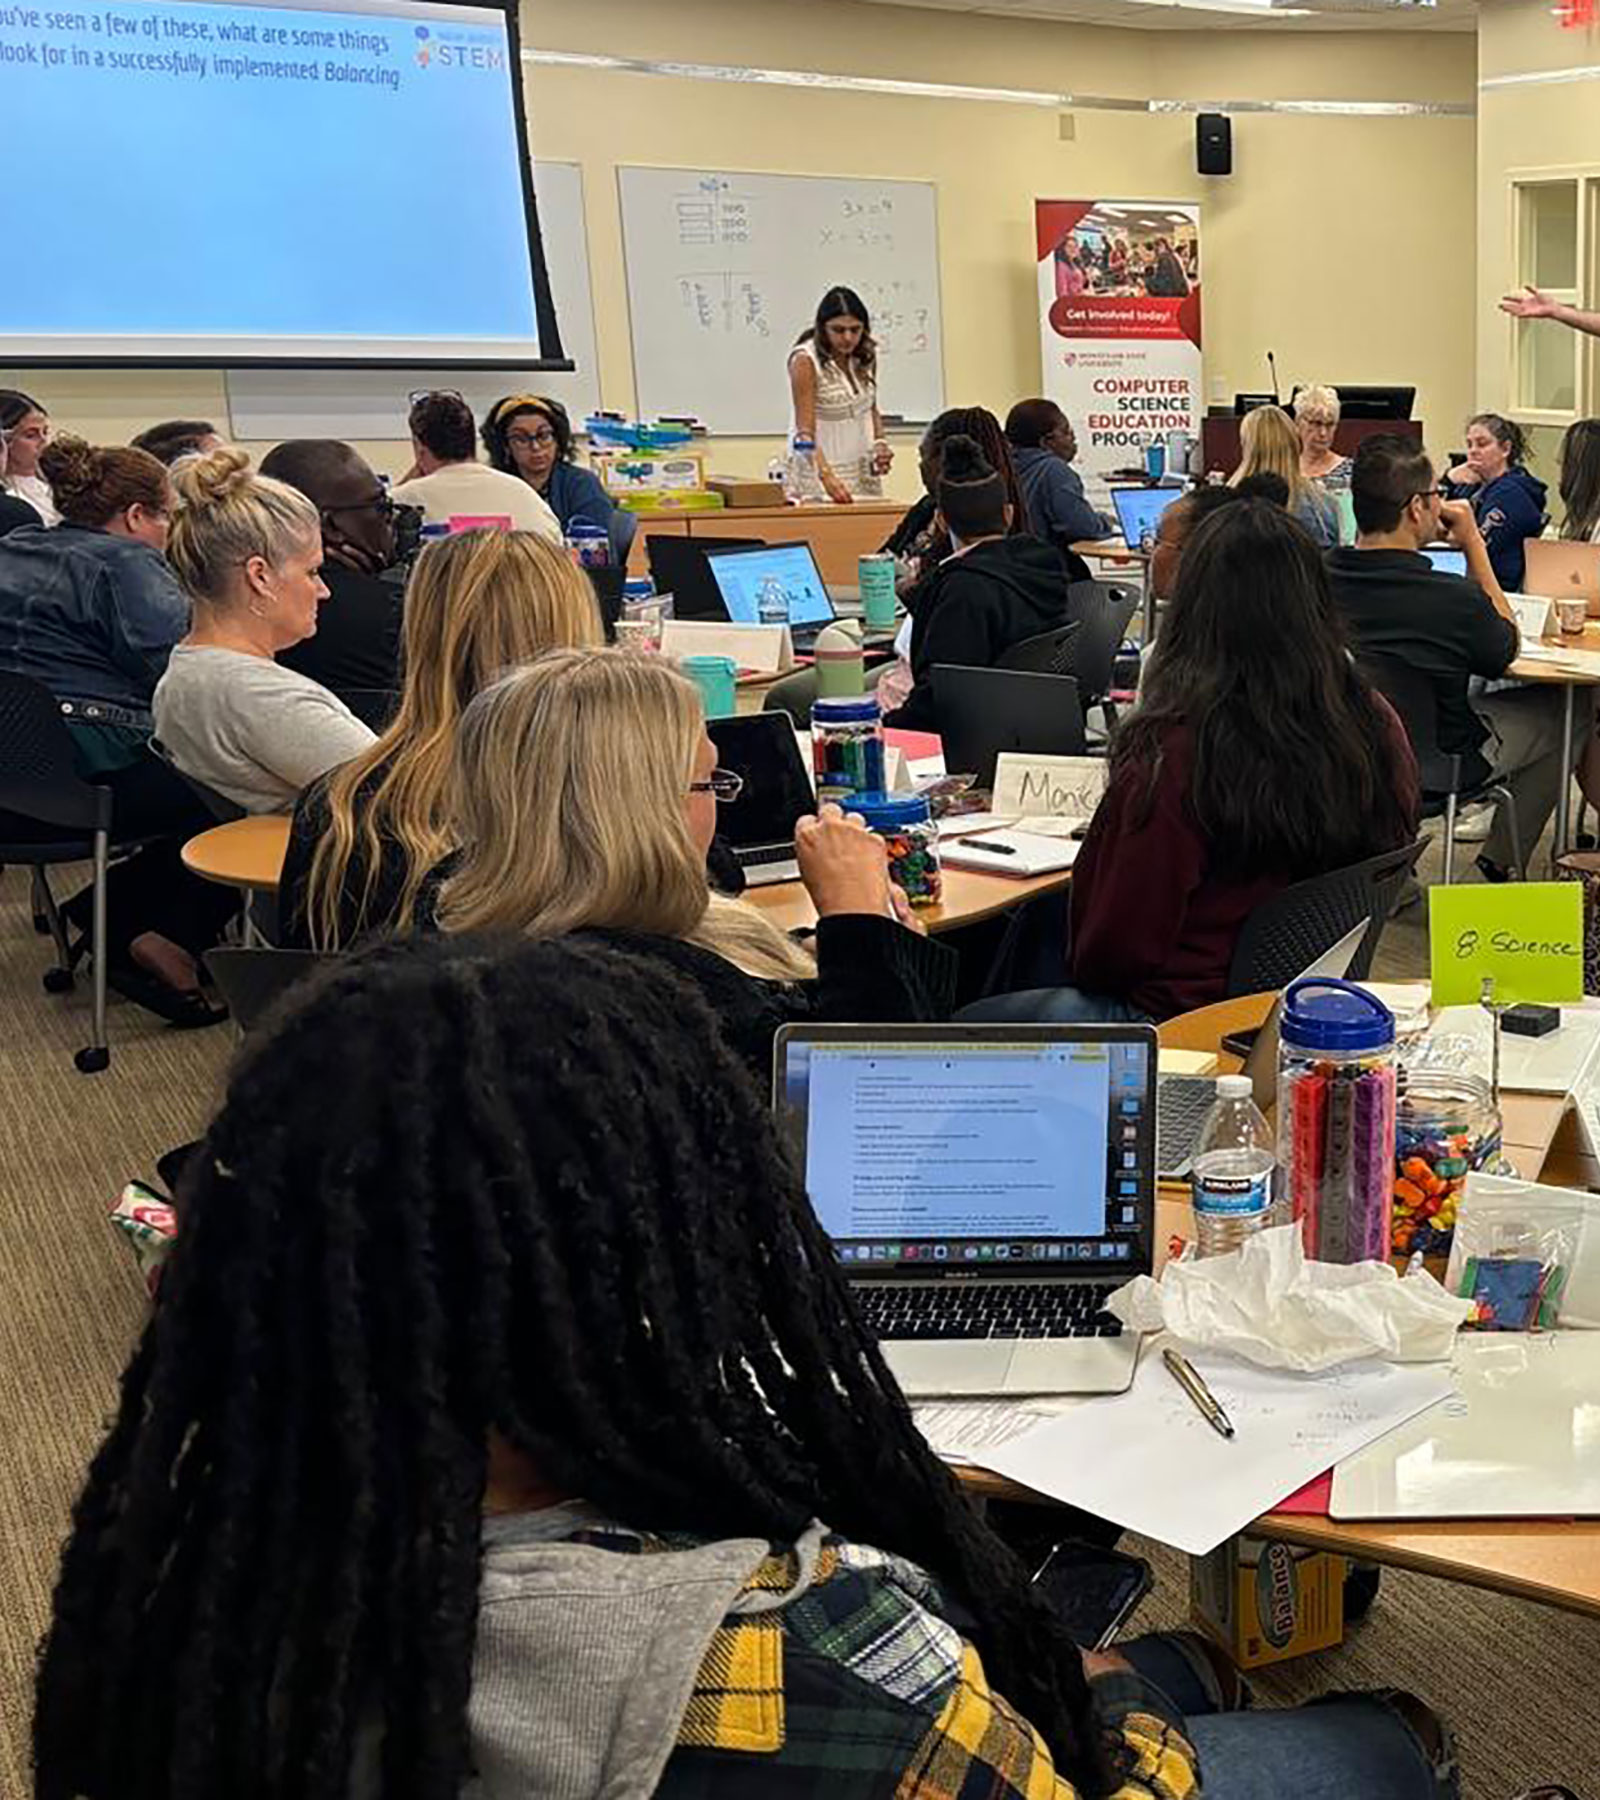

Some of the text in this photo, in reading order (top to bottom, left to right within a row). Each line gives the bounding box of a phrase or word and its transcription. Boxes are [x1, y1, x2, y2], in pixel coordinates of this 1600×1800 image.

[45, 12, 86, 30] seen
[91, 15, 100, 32] a
[105, 12, 137, 37] few
[142, 15, 158, 40] of
[162, 17, 214, 42] these,
[216, 22, 257, 43] what
[261, 28, 287, 45] are
[292, 29, 335, 48] some
[339, 29, 389, 56] things
[0, 41, 400, 91] look for in a successfully implemented Balancing
[439, 45, 505, 70] STEM
[1066, 308, 1171, 323] Get involved today!
[1093, 379, 1190, 394] COMPUTER
[1118, 397, 1190, 411] SCIENCE
[1088, 414, 1190, 429] EDUCATION
[1092, 432, 1176, 446] PROGA
[1491, 932, 1582, 957] Science
[1270, 1542, 1295, 1636] Balance
